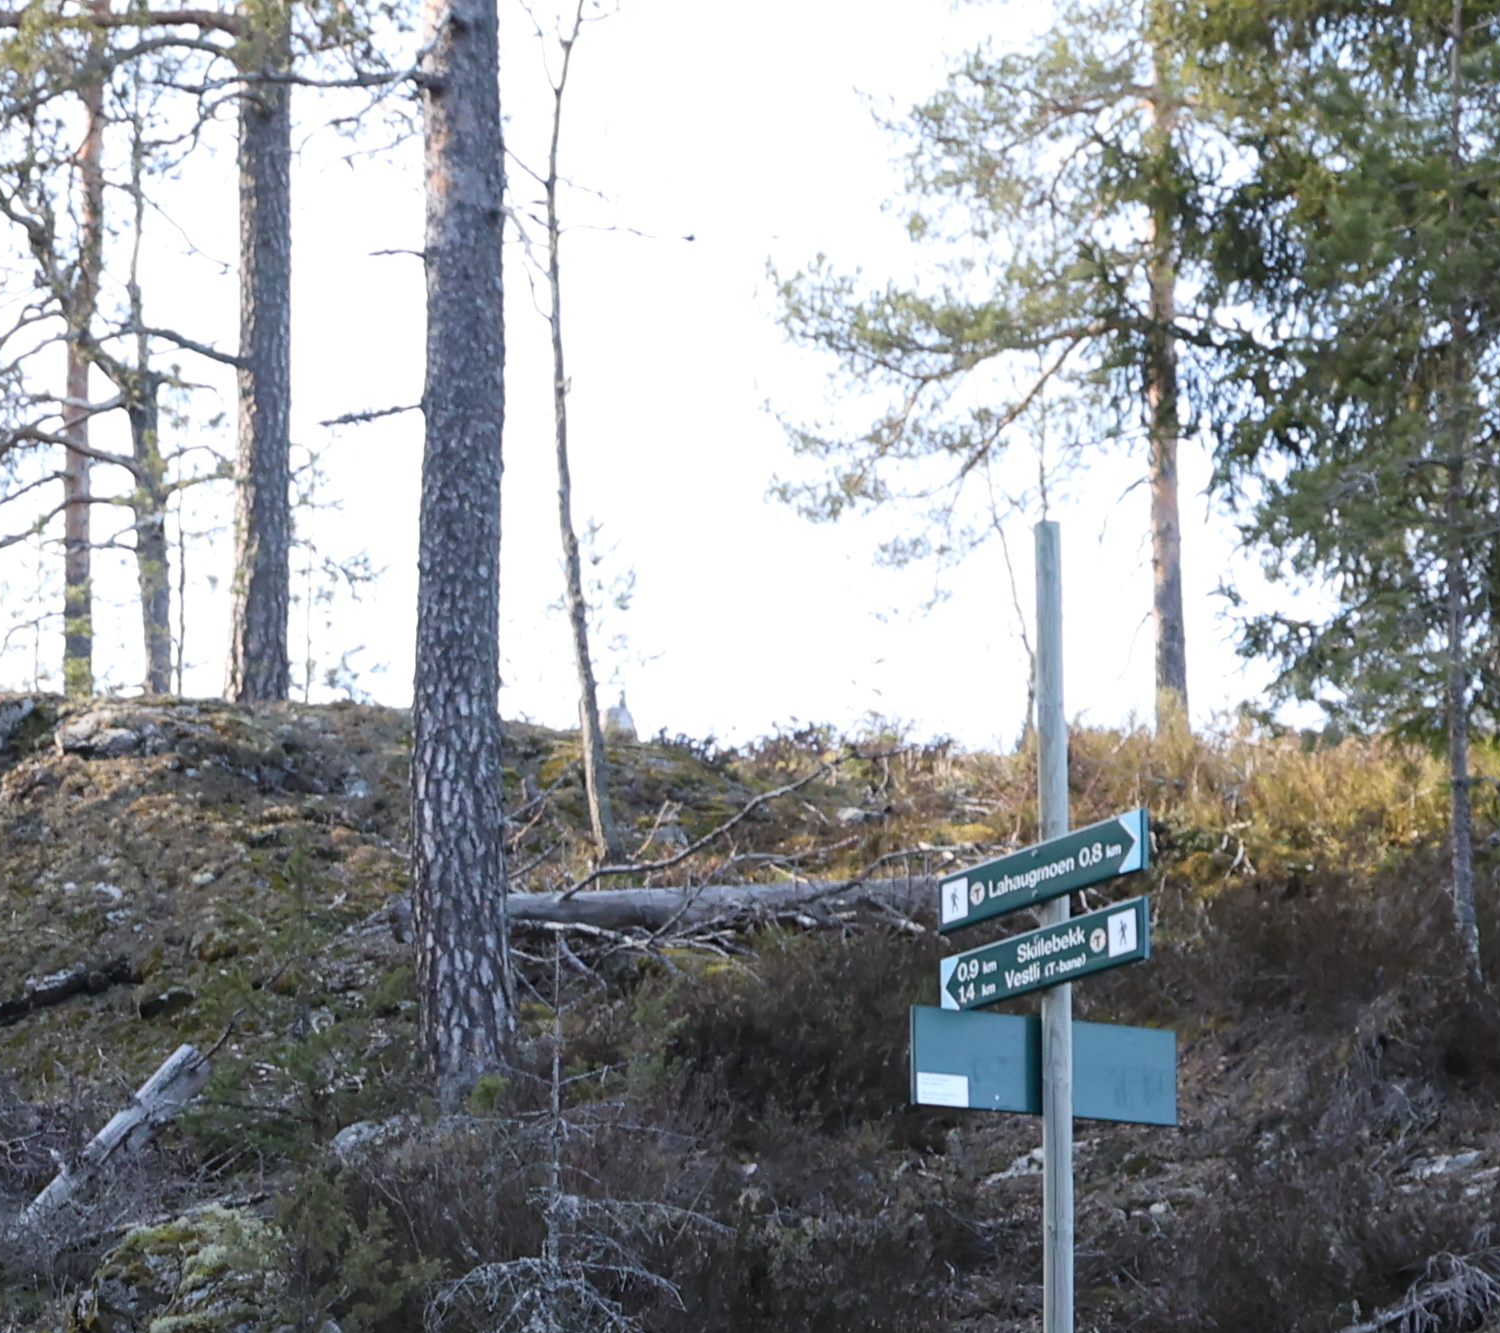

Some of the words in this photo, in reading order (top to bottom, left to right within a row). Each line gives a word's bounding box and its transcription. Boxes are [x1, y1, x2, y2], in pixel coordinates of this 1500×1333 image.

[988, 855, 1075, 899] Lahaugmoen
[1078, 842, 1103, 868] 0,8
[1106, 843, 1122, 859] km
[957, 959, 980, 983] 0,9
[983, 960, 997, 975] km
[1016, 926, 1086, 964] Skillebekk
[958, 983, 976, 1004] 1,4
[981, 983, 996, 997] km
[1004, 962, 1041, 990] Vestli
[1044, 952, 1087, 979] (T-bane)
